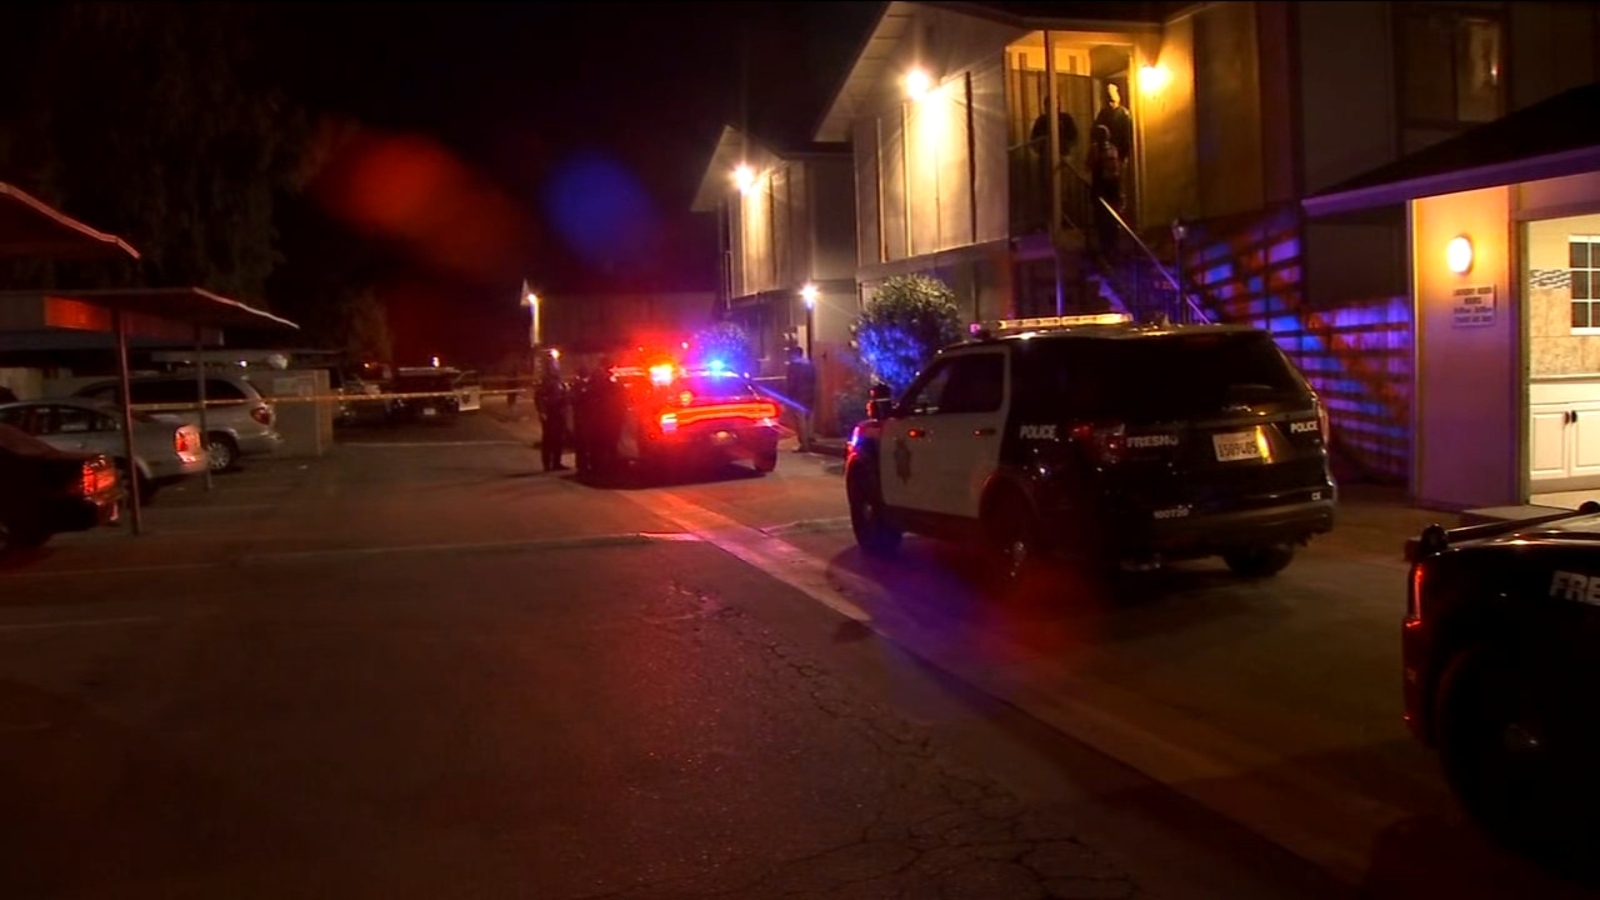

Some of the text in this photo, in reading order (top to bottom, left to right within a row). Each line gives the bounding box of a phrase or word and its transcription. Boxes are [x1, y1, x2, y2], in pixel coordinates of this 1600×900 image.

[1020, 425, 1056, 440] POLICE
[1290, 420, 1319, 433] POLICE
[1126, 434, 1179, 448] FRESNO
[1549, 569, 1600, 607] FRE
